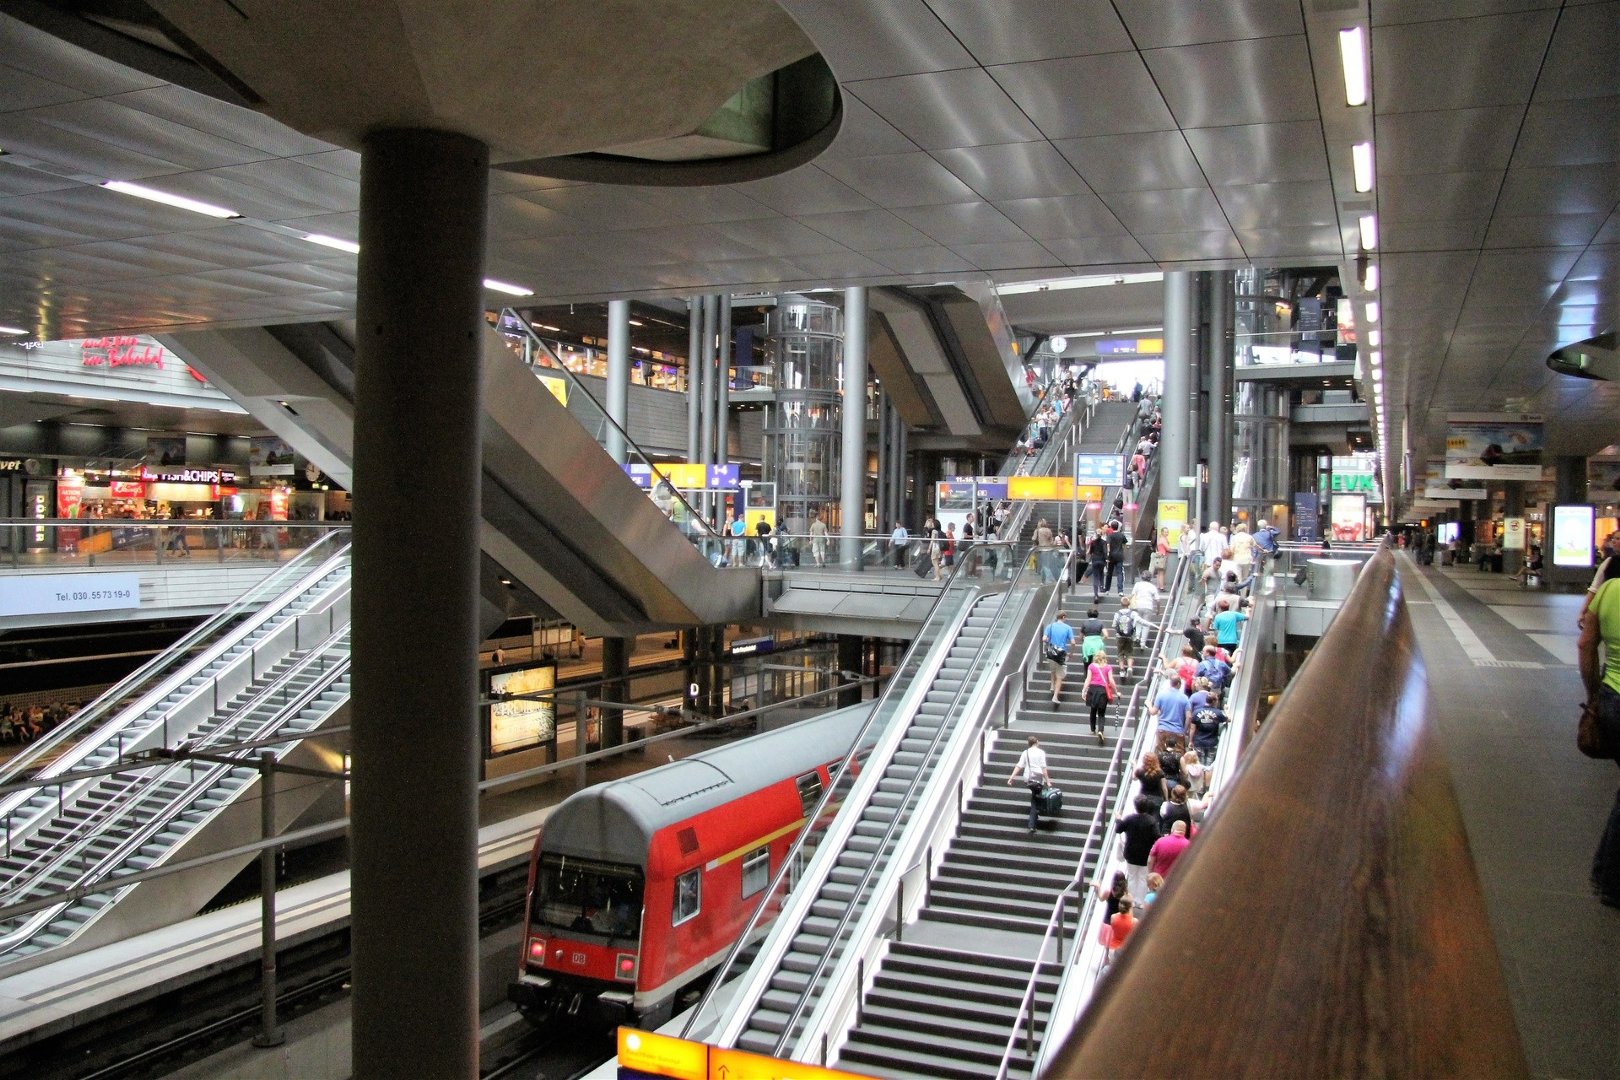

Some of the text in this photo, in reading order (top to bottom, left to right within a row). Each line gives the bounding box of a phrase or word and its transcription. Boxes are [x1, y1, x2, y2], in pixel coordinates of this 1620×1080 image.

[56, 592, 71, 601] Tel.
[690, 682, 699, 697] D
[573, 953, 585, 964] DB
